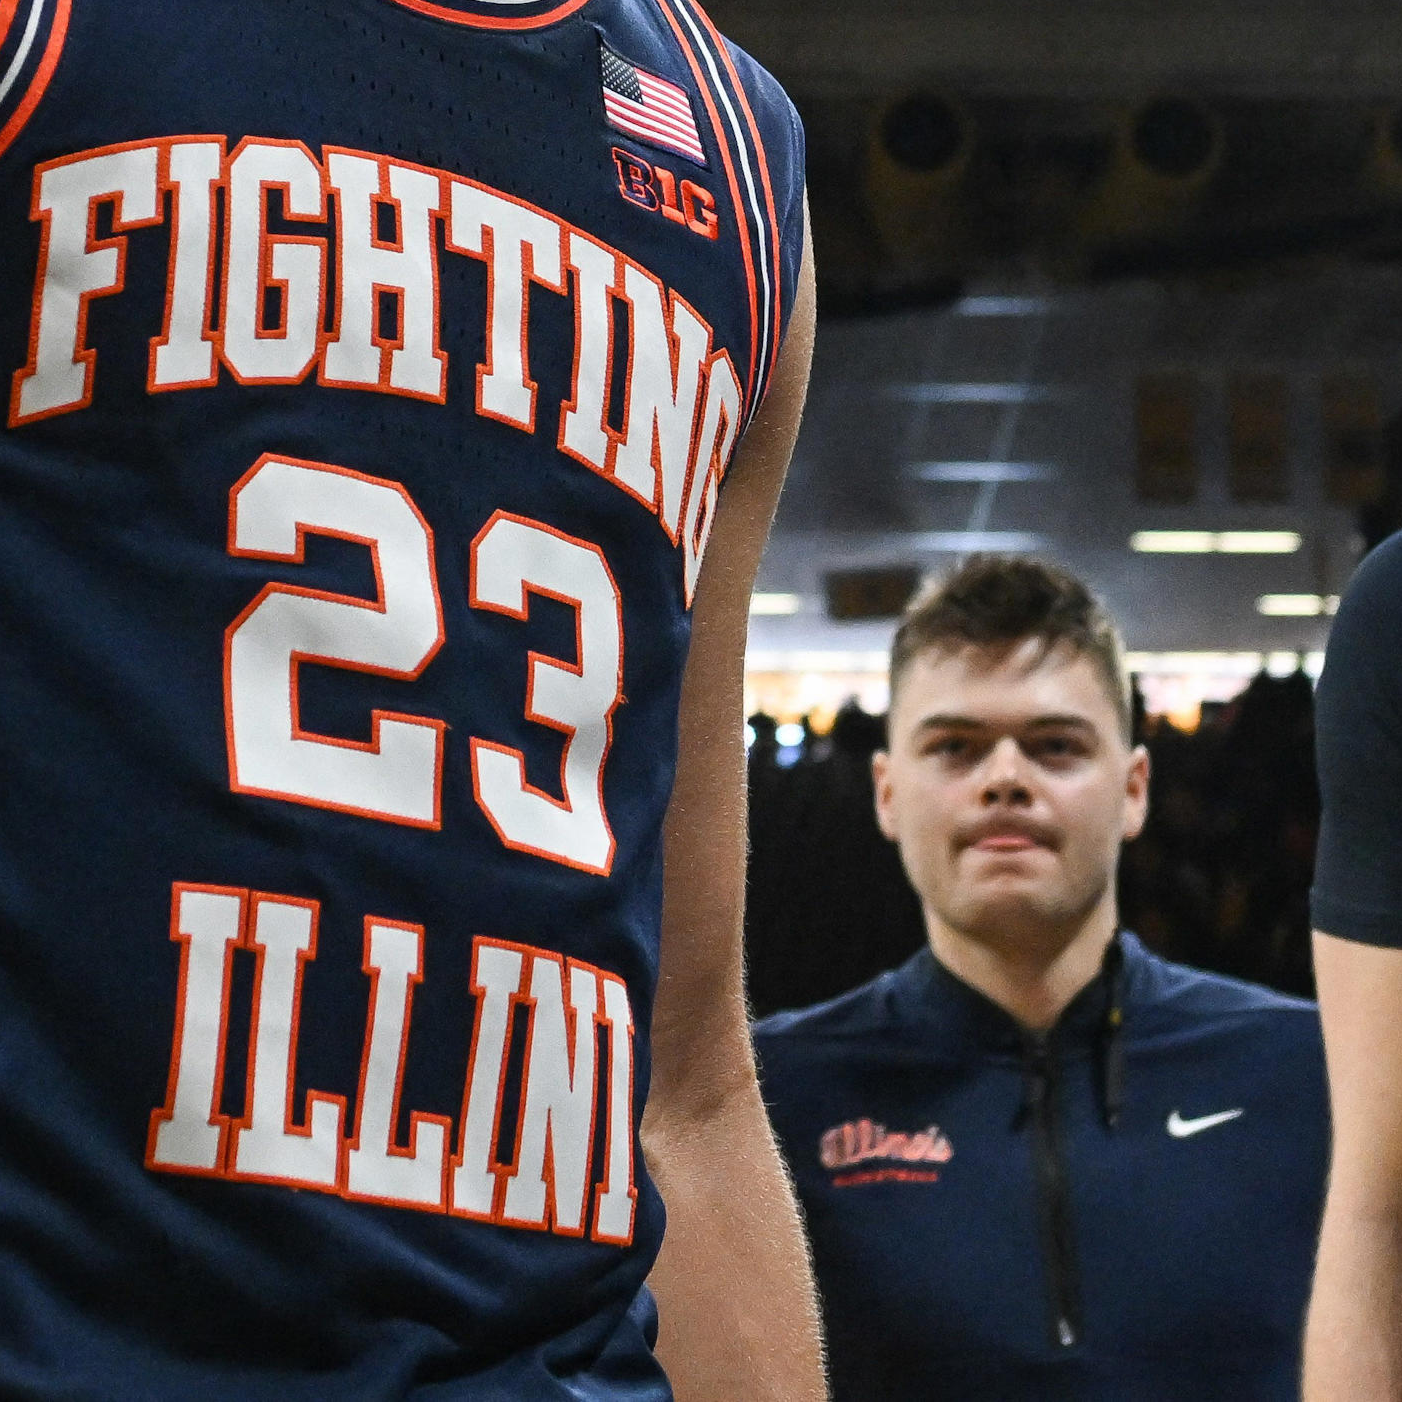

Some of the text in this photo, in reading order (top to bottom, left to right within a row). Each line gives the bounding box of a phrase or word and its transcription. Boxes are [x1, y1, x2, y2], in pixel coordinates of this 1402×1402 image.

[8, 134, 743, 610] FIGHTING
[225, 453, 625, 876] 23
[145, 881, 637, 1246] ILLINI
